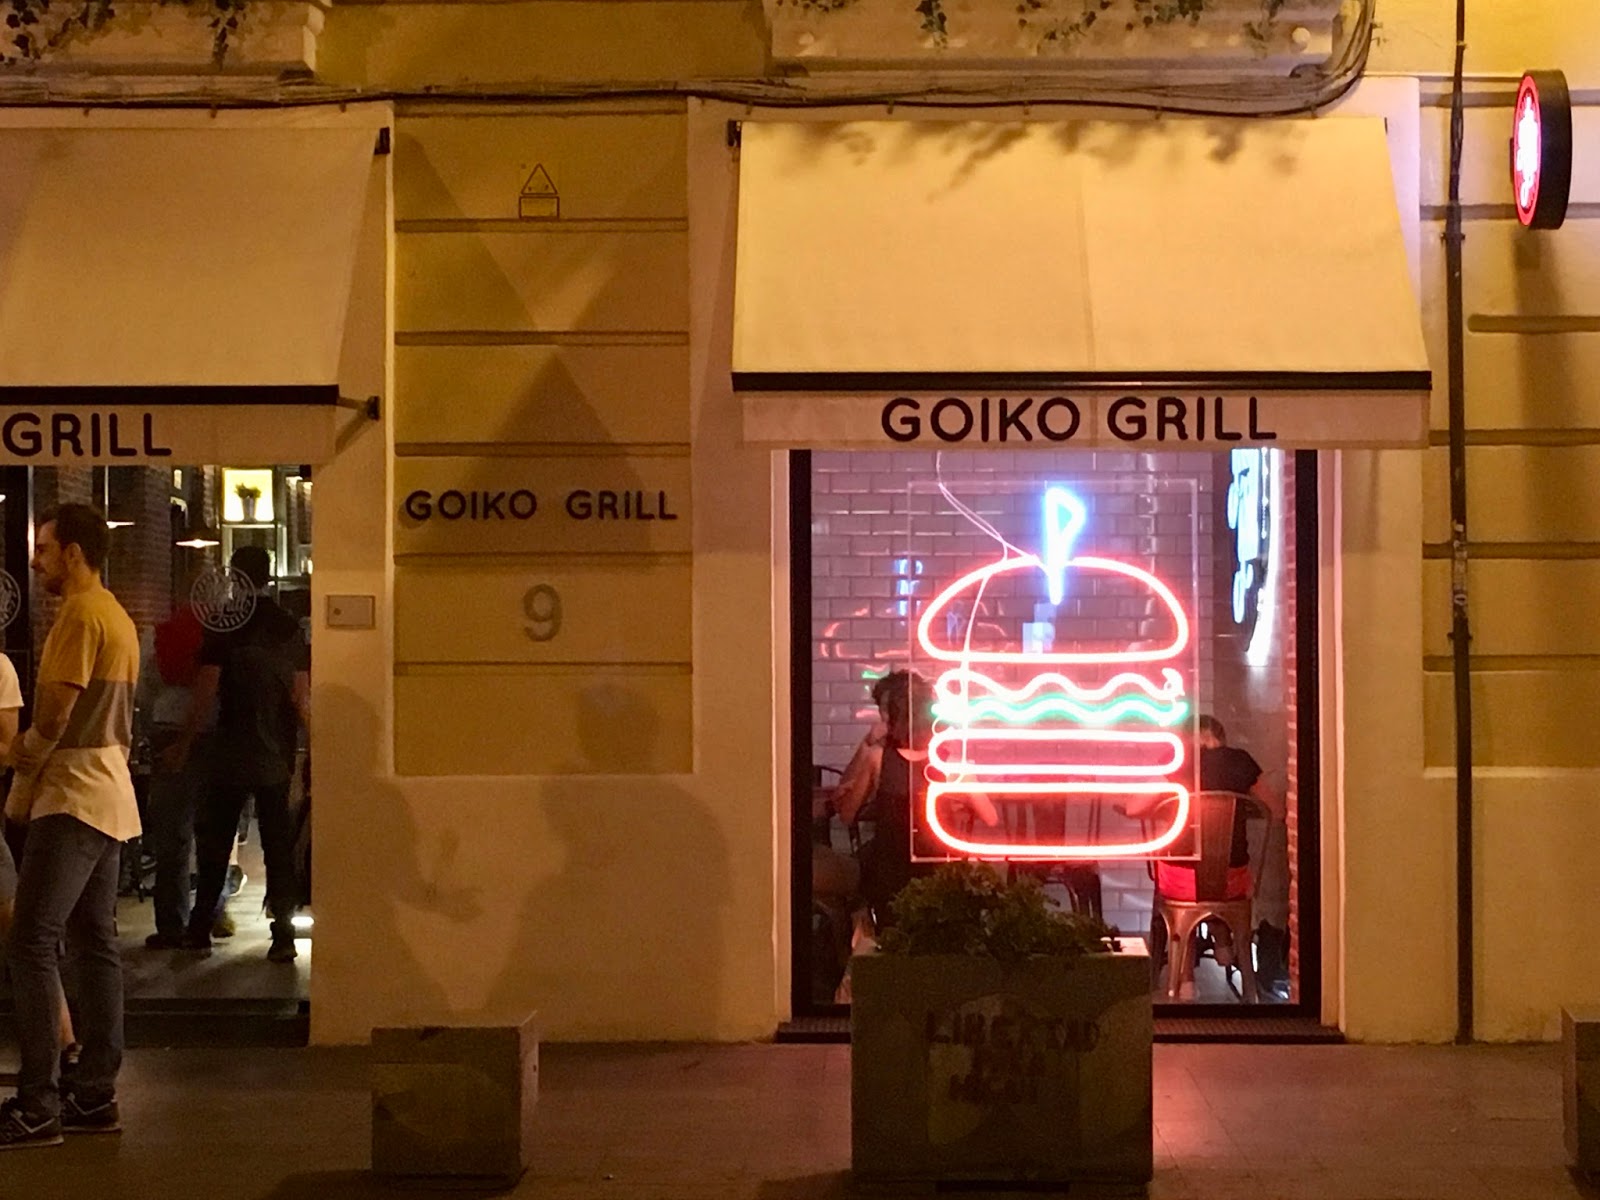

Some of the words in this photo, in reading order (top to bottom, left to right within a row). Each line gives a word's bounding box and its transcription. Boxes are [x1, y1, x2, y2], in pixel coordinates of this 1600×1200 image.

[2, 412, 172, 457] GRILL
[881, 396, 1081, 442] GOIKO
[1107, 396, 1278, 441] GRILL
[405, 489, 538, 521] GOIKO
[565, 489, 678, 520] GRILL
[522, 583, 563, 643] 9
